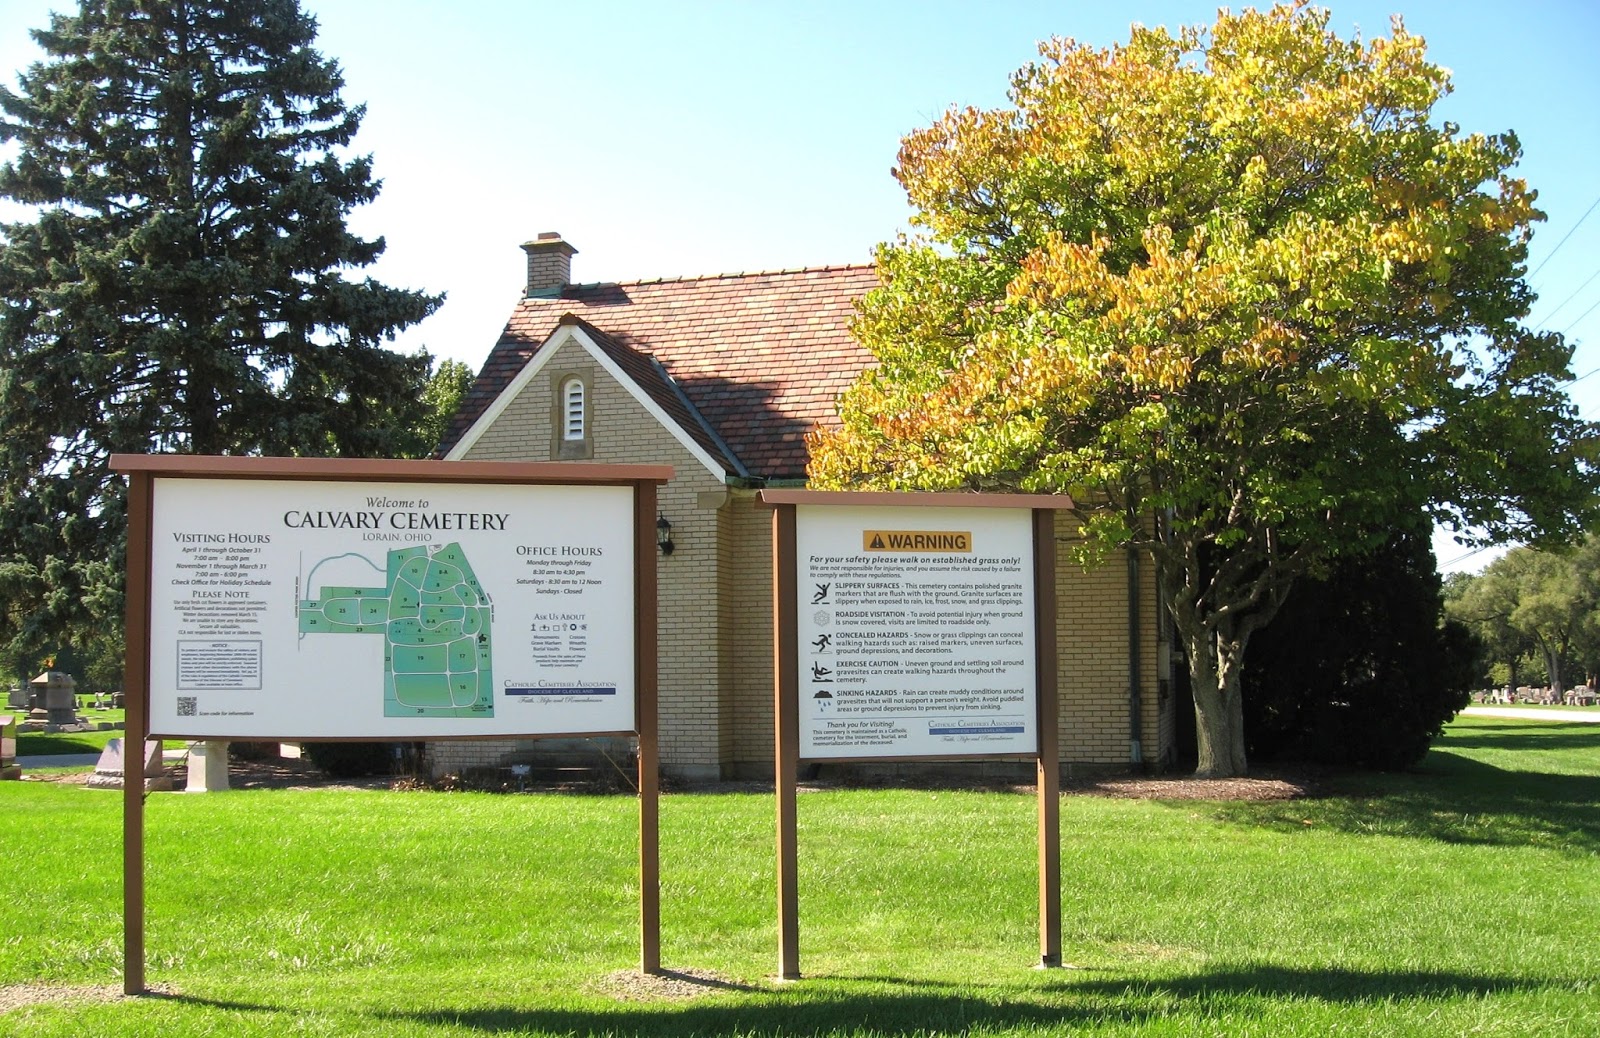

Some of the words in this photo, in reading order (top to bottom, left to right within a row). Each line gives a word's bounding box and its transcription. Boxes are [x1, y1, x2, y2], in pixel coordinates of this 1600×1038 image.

[368, 497, 414, 508] Welcome
[418, 499, 429, 508] to
[284, 511, 383, 528] CALVARY
[390, 513, 508, 530] CEMETERY
[173, 533, 225, 543] VISITING
[229, 534, 270, 543] HOURS
[363, 533, 401, 541] LORAIN,
[404, 533, 432, 542] OHIO
[888, 534, 966, 550] WARNING
[516, 546, 557, 556] OFFICE
[562, 546, 602, 556] HOURS
[846, 556, 870, 564] safety
[872, 556, 898, 564] please
[1001, 557, 1020, 565] only!
[504, 680, 537, 689] CATHOLIC
[538, 680, 575, 689] CEMETERIES
[576, 680, 616, 689] ASSOCIATION
